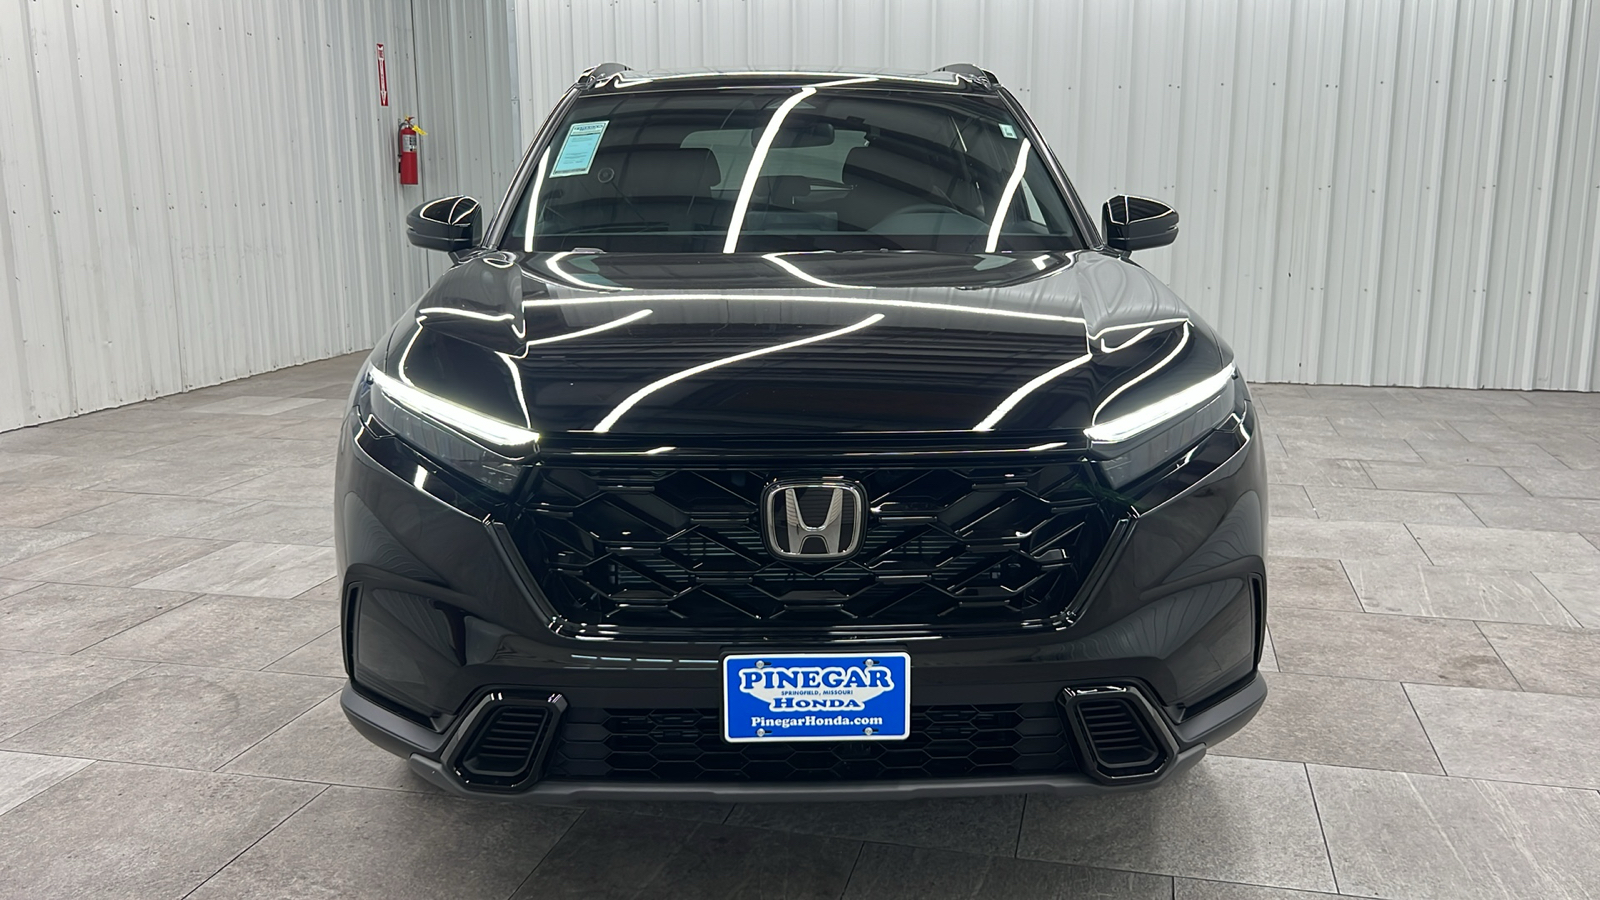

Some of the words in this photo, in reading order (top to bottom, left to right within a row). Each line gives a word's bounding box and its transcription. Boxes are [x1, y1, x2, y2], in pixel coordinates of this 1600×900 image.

[742, 669, 891, 690] PINEGAR
[772, 697, 862, 709] HONDA
[750, 715, 883, 729] PinegarHonda.com
